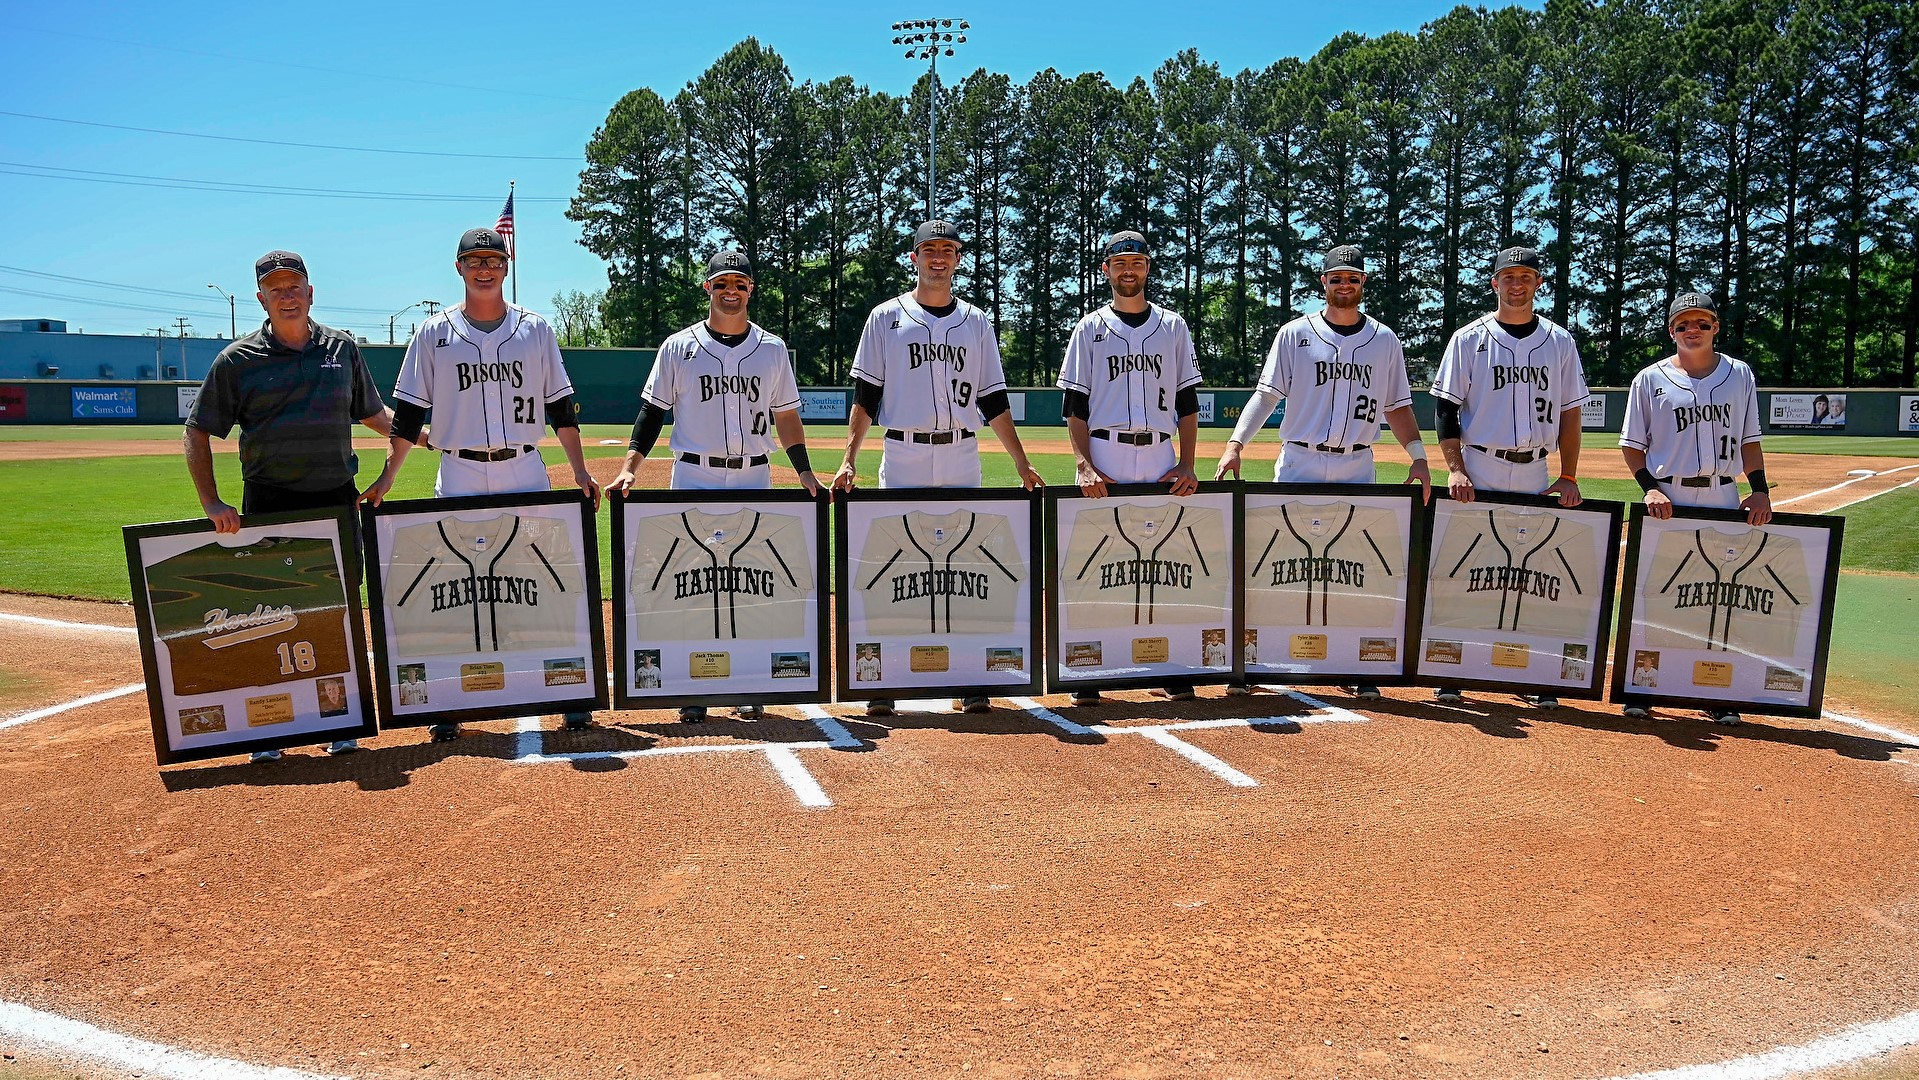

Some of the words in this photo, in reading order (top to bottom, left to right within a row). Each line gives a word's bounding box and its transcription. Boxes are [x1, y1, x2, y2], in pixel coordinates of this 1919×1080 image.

[908, 342, 966, 372] BISONS
[1106, 354, 1163, 382] BISONS
[456, 361, 523, 392] BISONS
[699, 374, 761, 403] BISONS
[1314, 360, 1372, 389] BISONS
[1492, 365, 1549, 391] BISONS
[75, 391, 118, 400] Walmart
[951, 378, 972, 408] 19
[93, 405, 114, 413] Sams
[115, 405, 133, 413] Club
[513, 396, 535, 424] 21
[1223, 407, 1240, 418] 365
[1353, 394, 1377, 424] 28
[1673, 403, 1731, 433] BISONS
[674, 566, 774, 600] HARDING
[892, 569, 989, 603] HARDING
[1099, 559, 1192, 590] HARDING
[1271, 558, 1365, 588] HARDING
[1467, 566, 1560, 602] HARDING
[431, 575, 538, 613] HARDING
[1675, 582, 1774, 615] HARDING
[277, 641, 316, 675] 18
